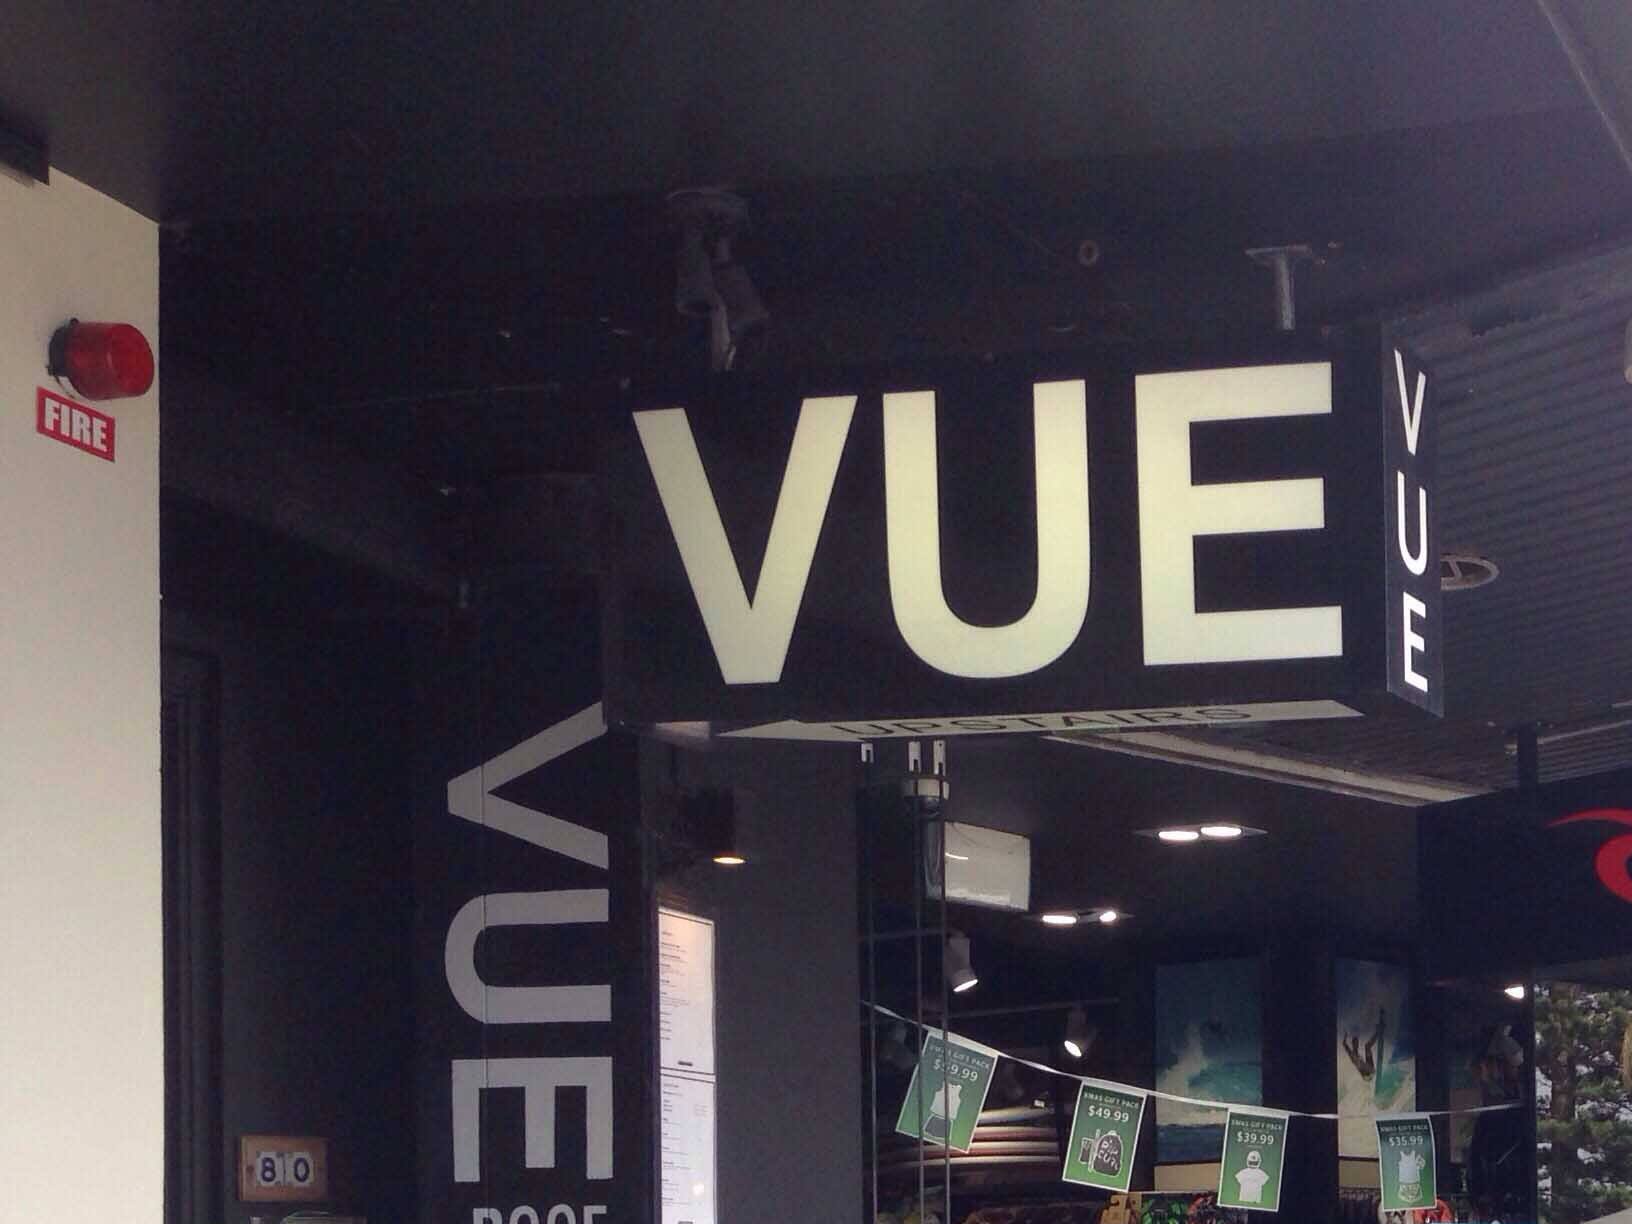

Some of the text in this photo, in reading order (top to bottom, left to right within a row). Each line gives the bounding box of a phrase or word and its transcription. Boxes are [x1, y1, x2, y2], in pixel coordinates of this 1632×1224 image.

[45, 397, 107, 453] FIRE
[631, 361, 1343, 686] VUE
[1393, 347, 1429, 693] VUE
[830, 707, 1252, 740] UPSTAIRS
[444, 701, 614, 1183] VUE
[1088, 1104, 1130, 1123] $49.99
[1237, 1131, 1275, 1145] $39.99
[1388, 1135, 1424, 1147] $35.99
[258, 1155, 311, 1185] 80
